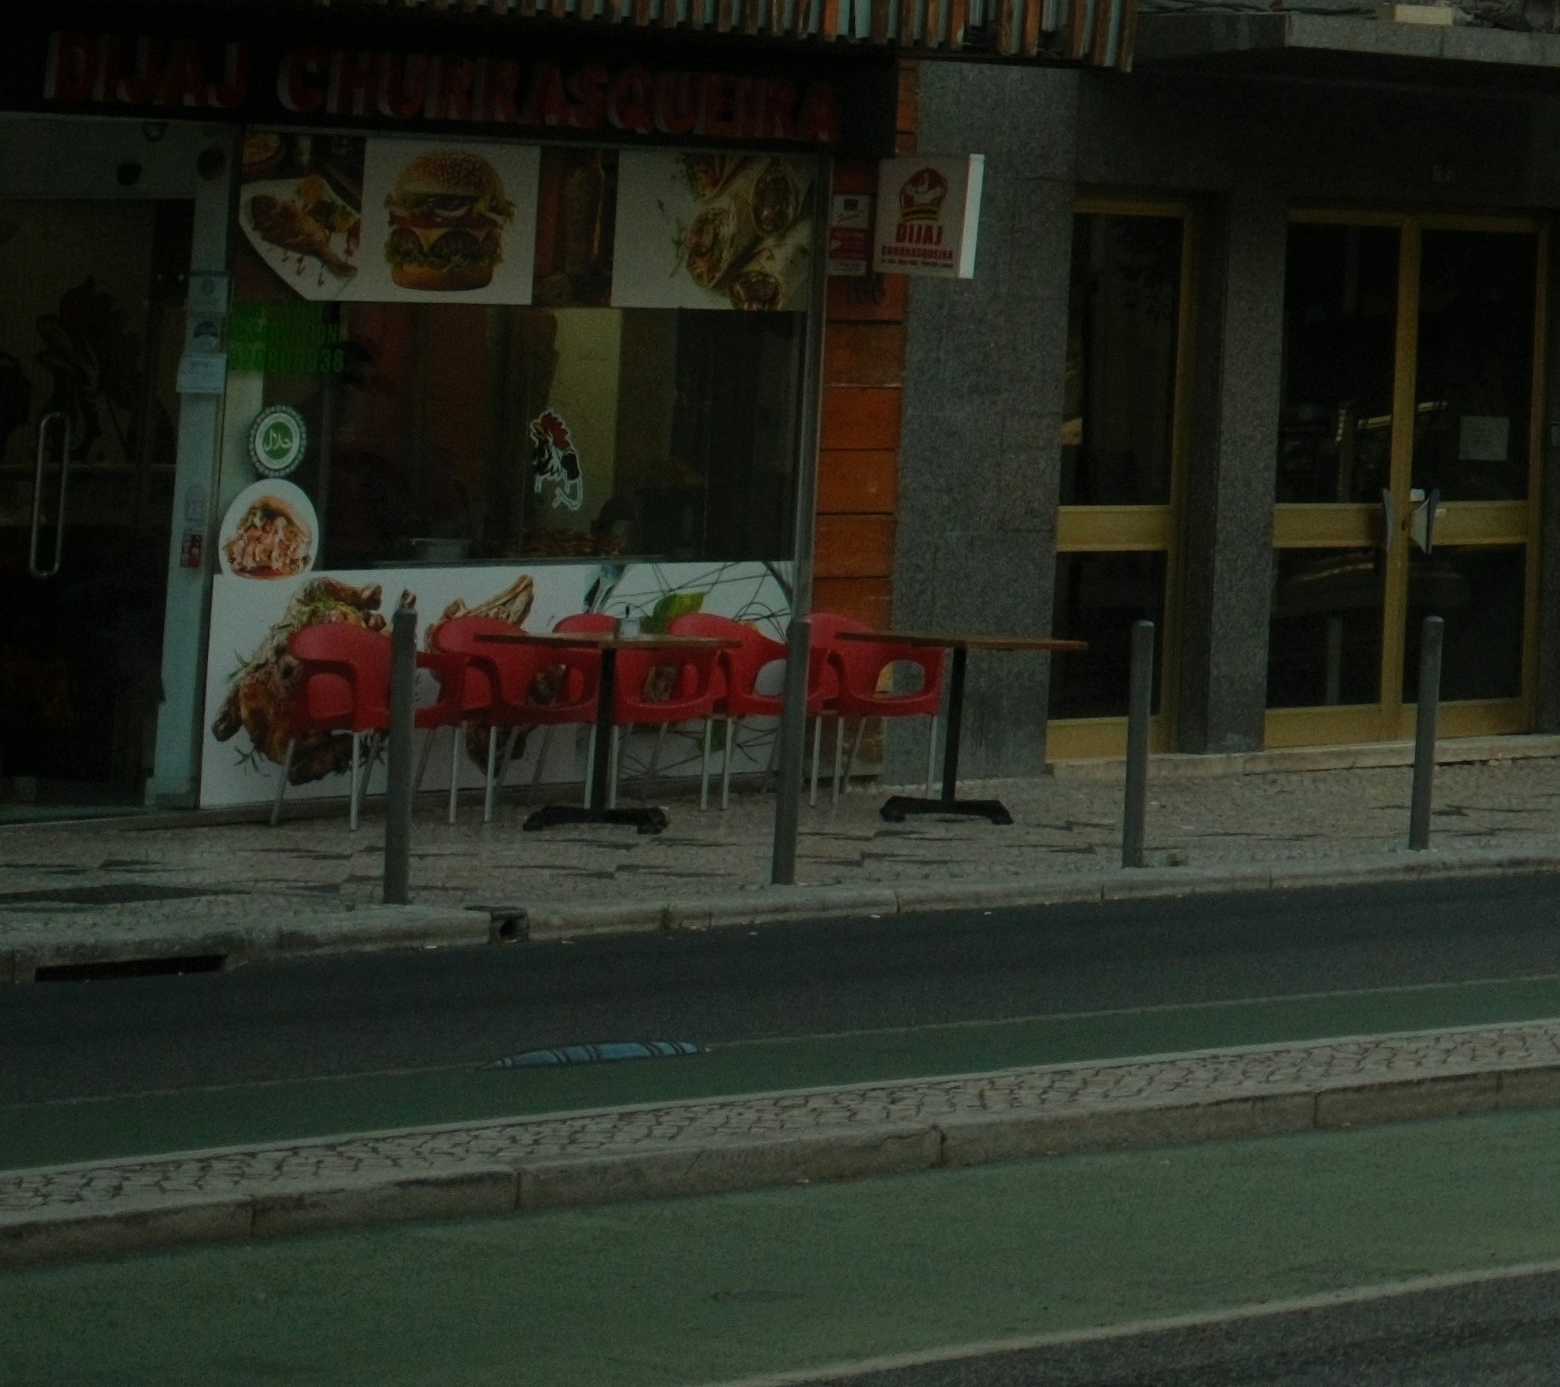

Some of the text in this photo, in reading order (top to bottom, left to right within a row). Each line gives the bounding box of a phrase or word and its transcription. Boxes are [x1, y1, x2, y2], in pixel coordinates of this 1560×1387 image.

[42, 30, 842, 143] DIJAJ CHURRASQUEIRA
[895, 223, 943, 245] DIJAJ
